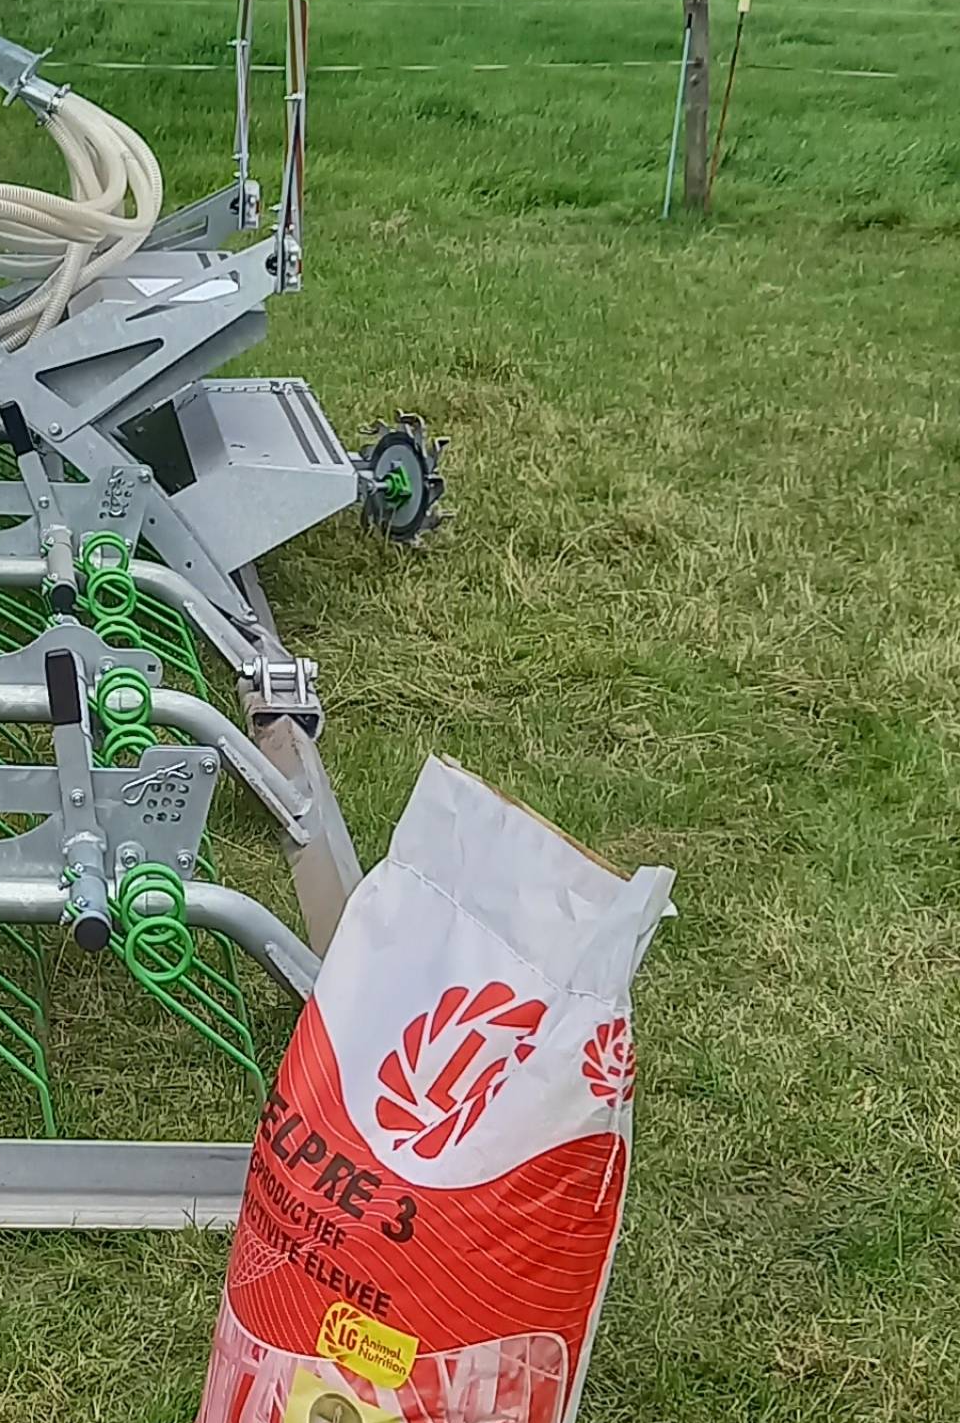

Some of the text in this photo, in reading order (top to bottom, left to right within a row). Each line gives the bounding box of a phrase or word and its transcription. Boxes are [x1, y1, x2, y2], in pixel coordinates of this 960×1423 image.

[248, 1144, 348, 1251] GPRODUCTIEF
[258, 1080, 418, 1244] ELPRE 3
[338, 1324, 402, 1361] LG Animal
[357, 1346, 407, 1377] Nutrition
